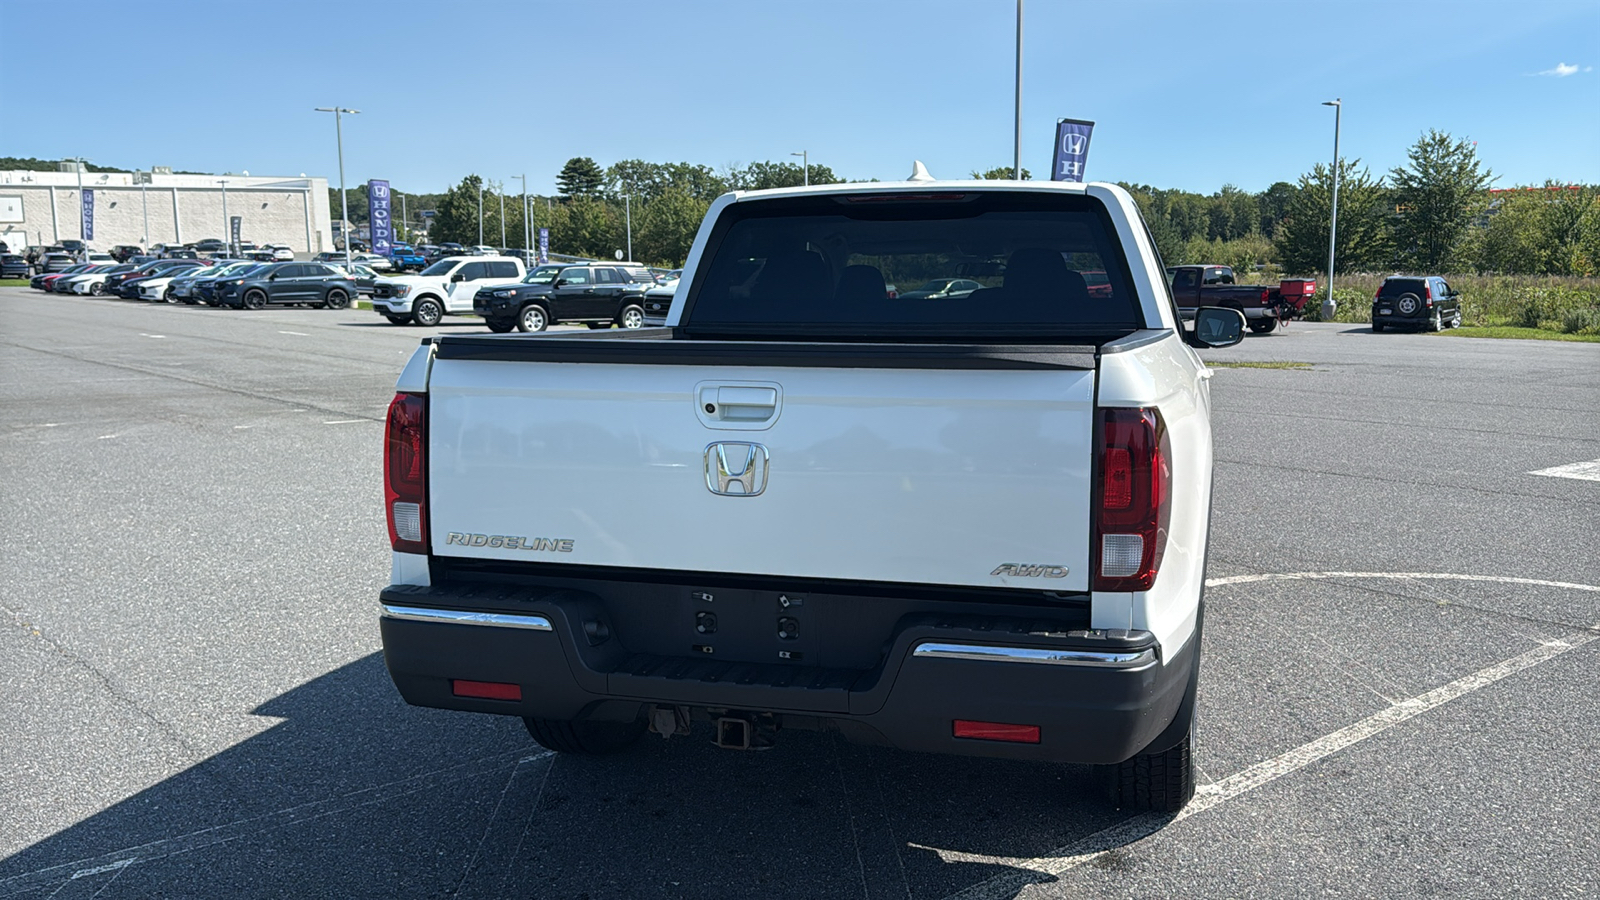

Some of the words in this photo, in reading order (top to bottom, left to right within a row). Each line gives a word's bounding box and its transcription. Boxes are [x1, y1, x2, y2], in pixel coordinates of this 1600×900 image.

[373, 200, 390, 247] HONDA
[446, 531, 575, 553] RIDGELINE
[990, 562, 1070, 579] AWD
